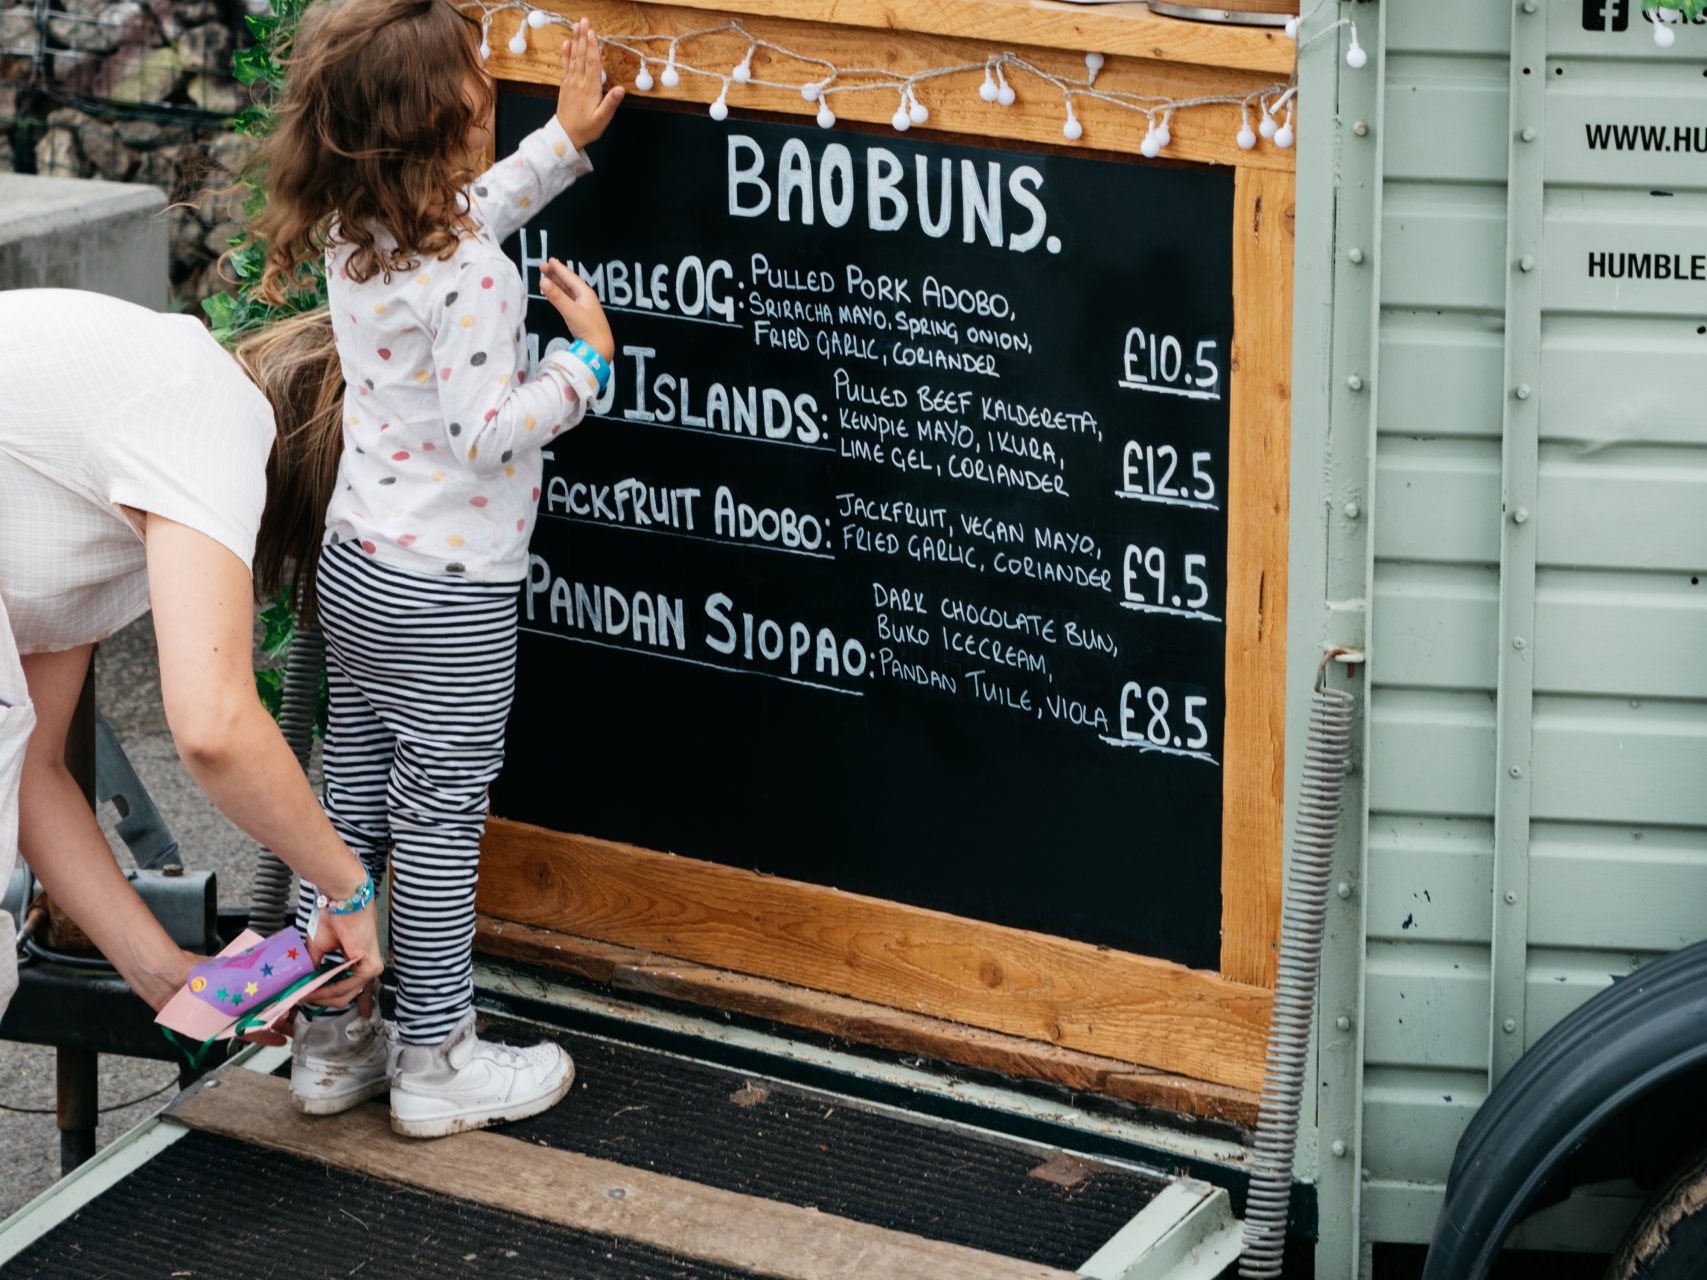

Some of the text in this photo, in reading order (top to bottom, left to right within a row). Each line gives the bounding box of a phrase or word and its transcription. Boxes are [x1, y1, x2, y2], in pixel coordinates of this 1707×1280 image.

[728, 134, 1062, 254] BAOBUNS.
[751, 253, 1015, 321] PULLED PORK ADOBO,
[1588, 252, 1706, 280] HUMBLE
[749, 291, 833, 325] SRIRACHA
[895, 310, 958, 344] SPRING
[967, 327, 1032, 354] ONION,
[754, 320, 1000, 378] FRIED GARLIC, CORIANDER
[1124, 327, 1219, 387] £10.5
[623, 345, 829, 444] ISLANDS:
[834, 368, 1102, 442] PULLED BEEF KALDERETA,
[840, 407, 1064, 470] KEWPIE MAYO, IKURA,
[841, 437, 1069, 497] LIME GEL, CORIANDER
[1123, 440, 1215, 500] £12.5
[541, 451, 831, 549] ACKFRUIT ADOBO:
[836, 493, 953, 537] JACKFRUIT,
[960, 513, 1024, 544] VEGAN
[842, 524, 1111, 592] FRIED GARLIC, CORIANDER
[1123, 543, 1208, 608] £9.5
[526, 554, 875, 678] PANDAN SIOPAO:
[872, 582, 1118, 658] DARK CHOCOLATE BUN,
[877, 614, 929, 646] BUKO
[879, 647, 1108, 732] PANDAN TUILE, VIOLA
[1120, 681, 1208, 748] £8.5
